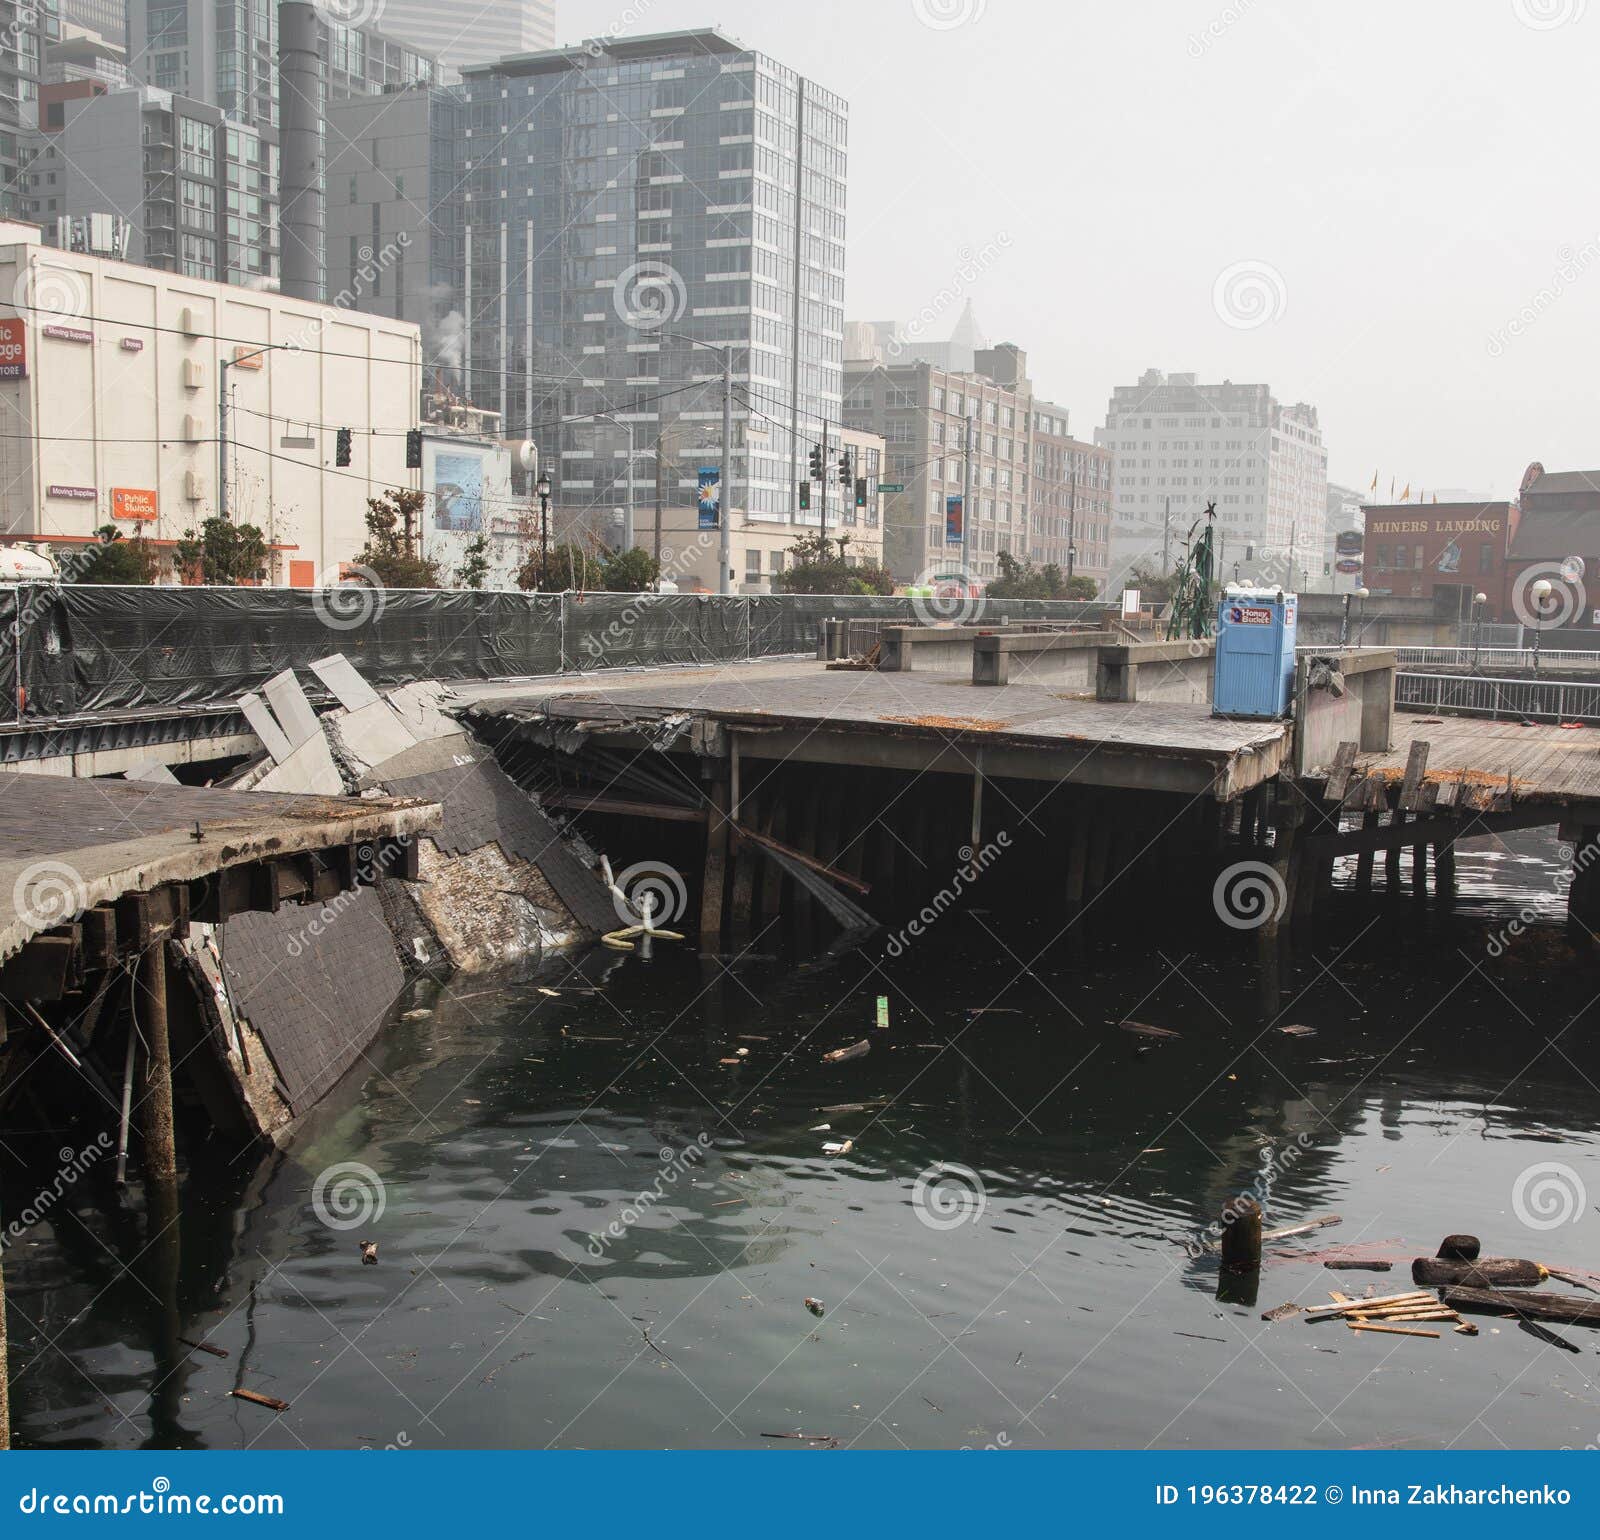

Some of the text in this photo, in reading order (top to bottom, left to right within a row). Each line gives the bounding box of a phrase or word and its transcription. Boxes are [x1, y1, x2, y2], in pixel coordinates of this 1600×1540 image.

[48, 326, 93, 341] Moving Supplies
[52, 487, 96, 498] Moving Supplies
[124, 493, 149, 505] Public
[124, 503, 155, 515] Storage
[1373, 519, 1500, 533] MINERS LANDING
[1241, 608, 1268, 618] Honey
[1242, 616, 1270, 624] Bucket
